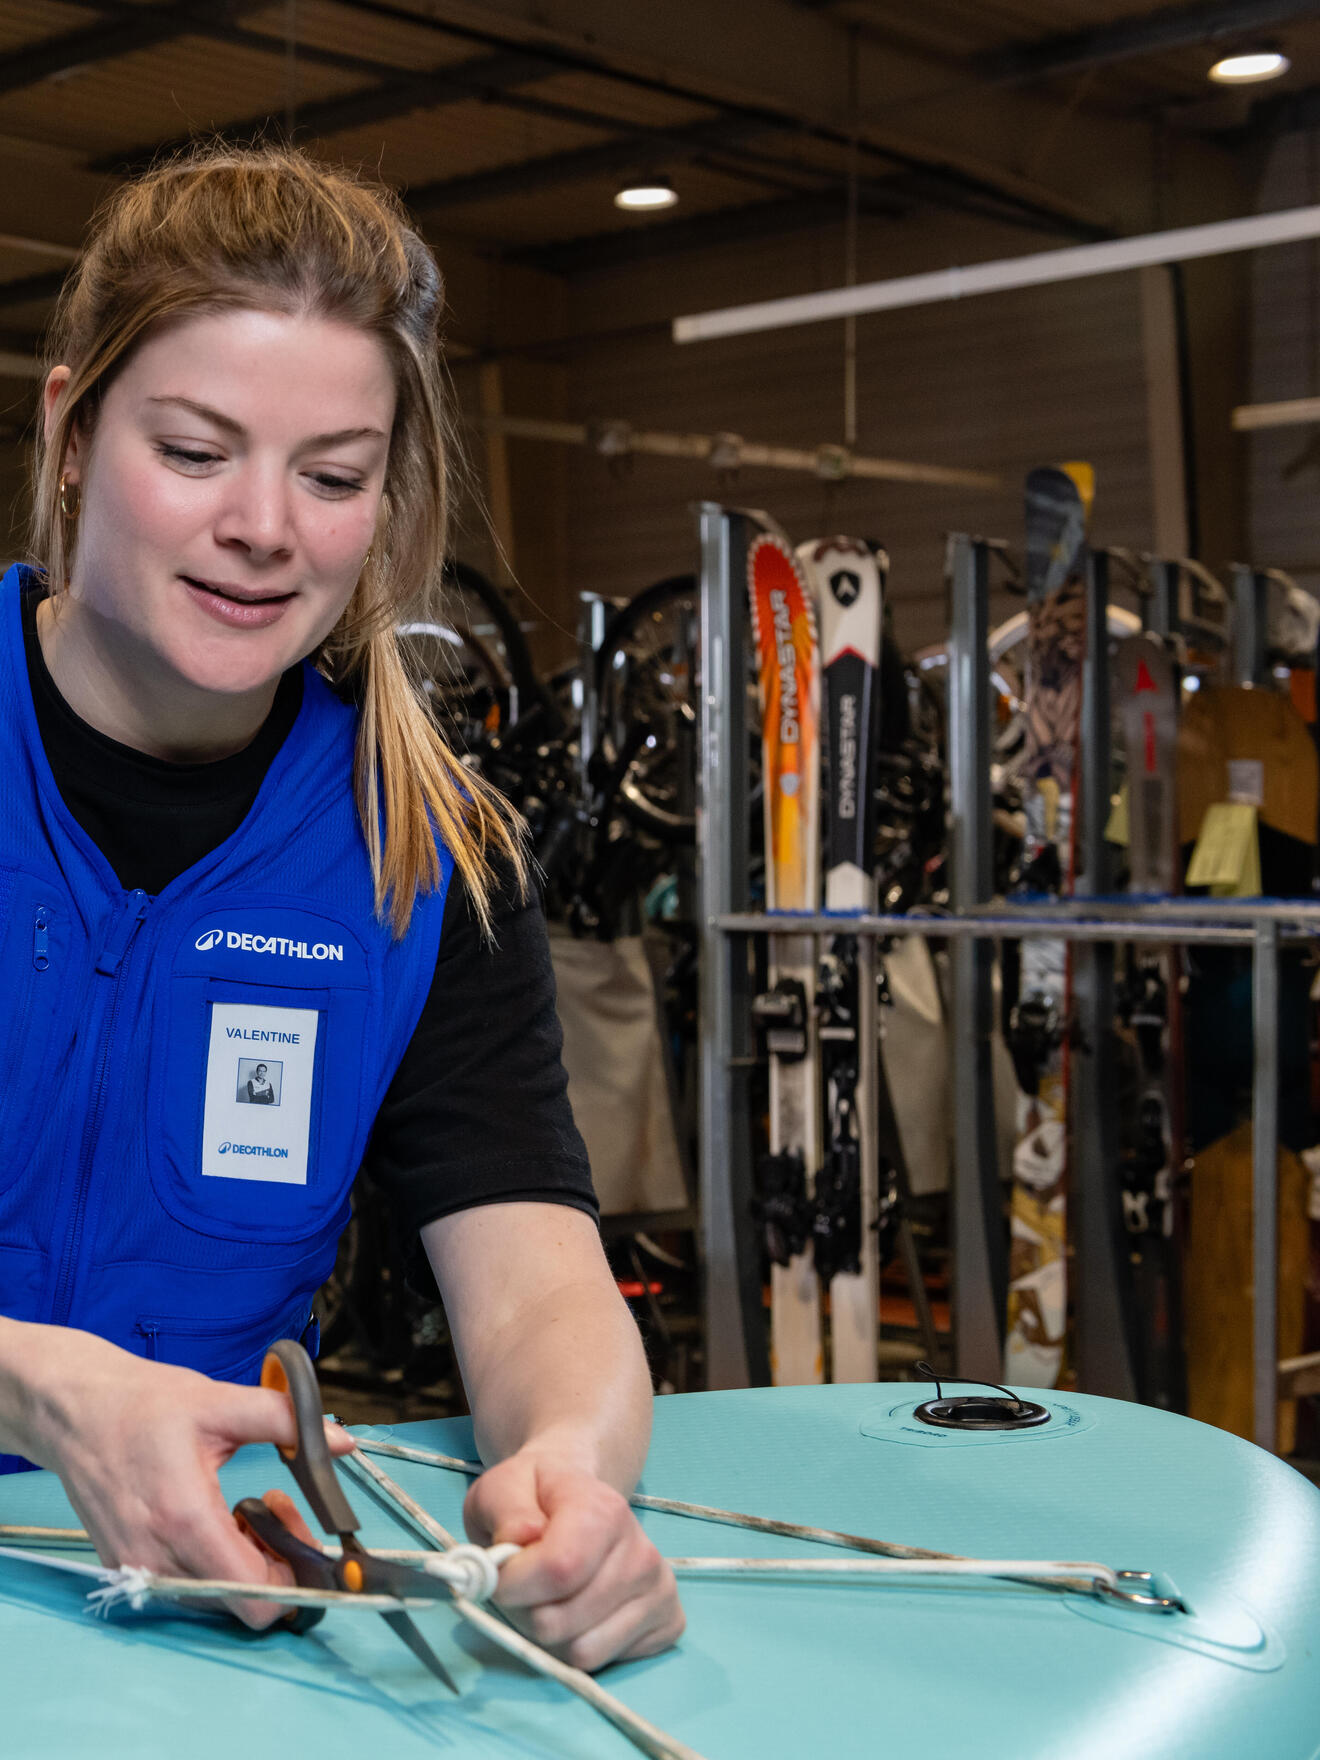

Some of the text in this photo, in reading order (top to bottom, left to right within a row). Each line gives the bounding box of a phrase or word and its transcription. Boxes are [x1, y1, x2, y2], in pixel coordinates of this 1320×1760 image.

[769, 588, 799, 743] DYNASTAR
[838, 694, 856, 819] DYNASTAR
[226, 931, 343, 961] DECATHLON
[225, 1027, 300, 1045] VALENTINE
[232, 1143, 288, 1159] DECATHLON
